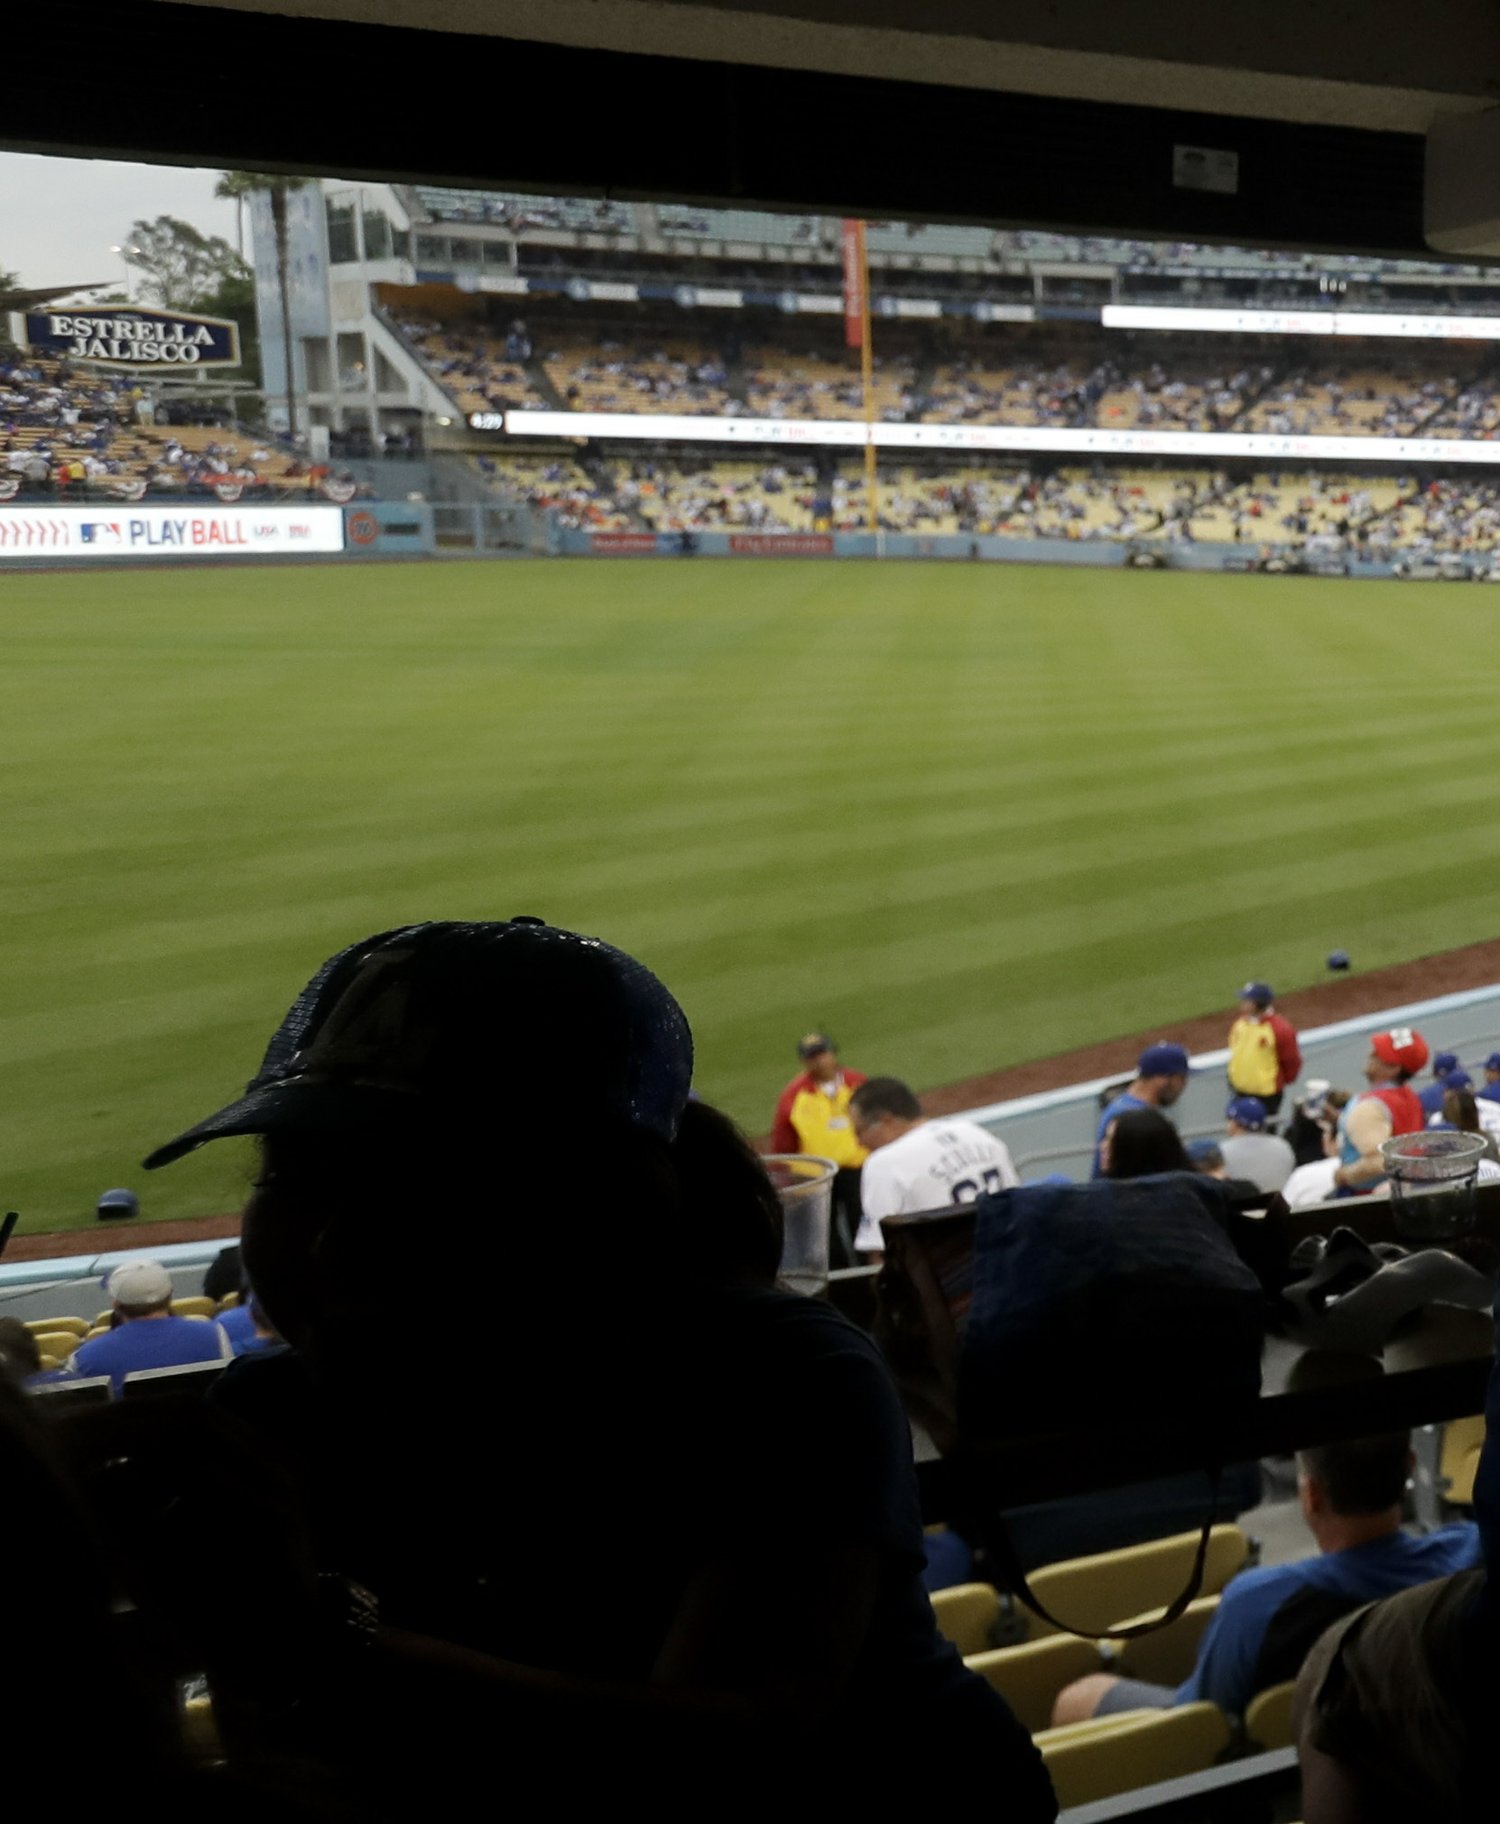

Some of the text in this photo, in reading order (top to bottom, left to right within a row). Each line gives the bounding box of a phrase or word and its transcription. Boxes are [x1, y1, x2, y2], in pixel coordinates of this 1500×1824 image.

[50, 315, 215, 346] ESTRELLA
[69, 338, 200, 364] JALISCO
[130, 520, 187, 546] PLAY
[192, 519, 248, 545] BALL
